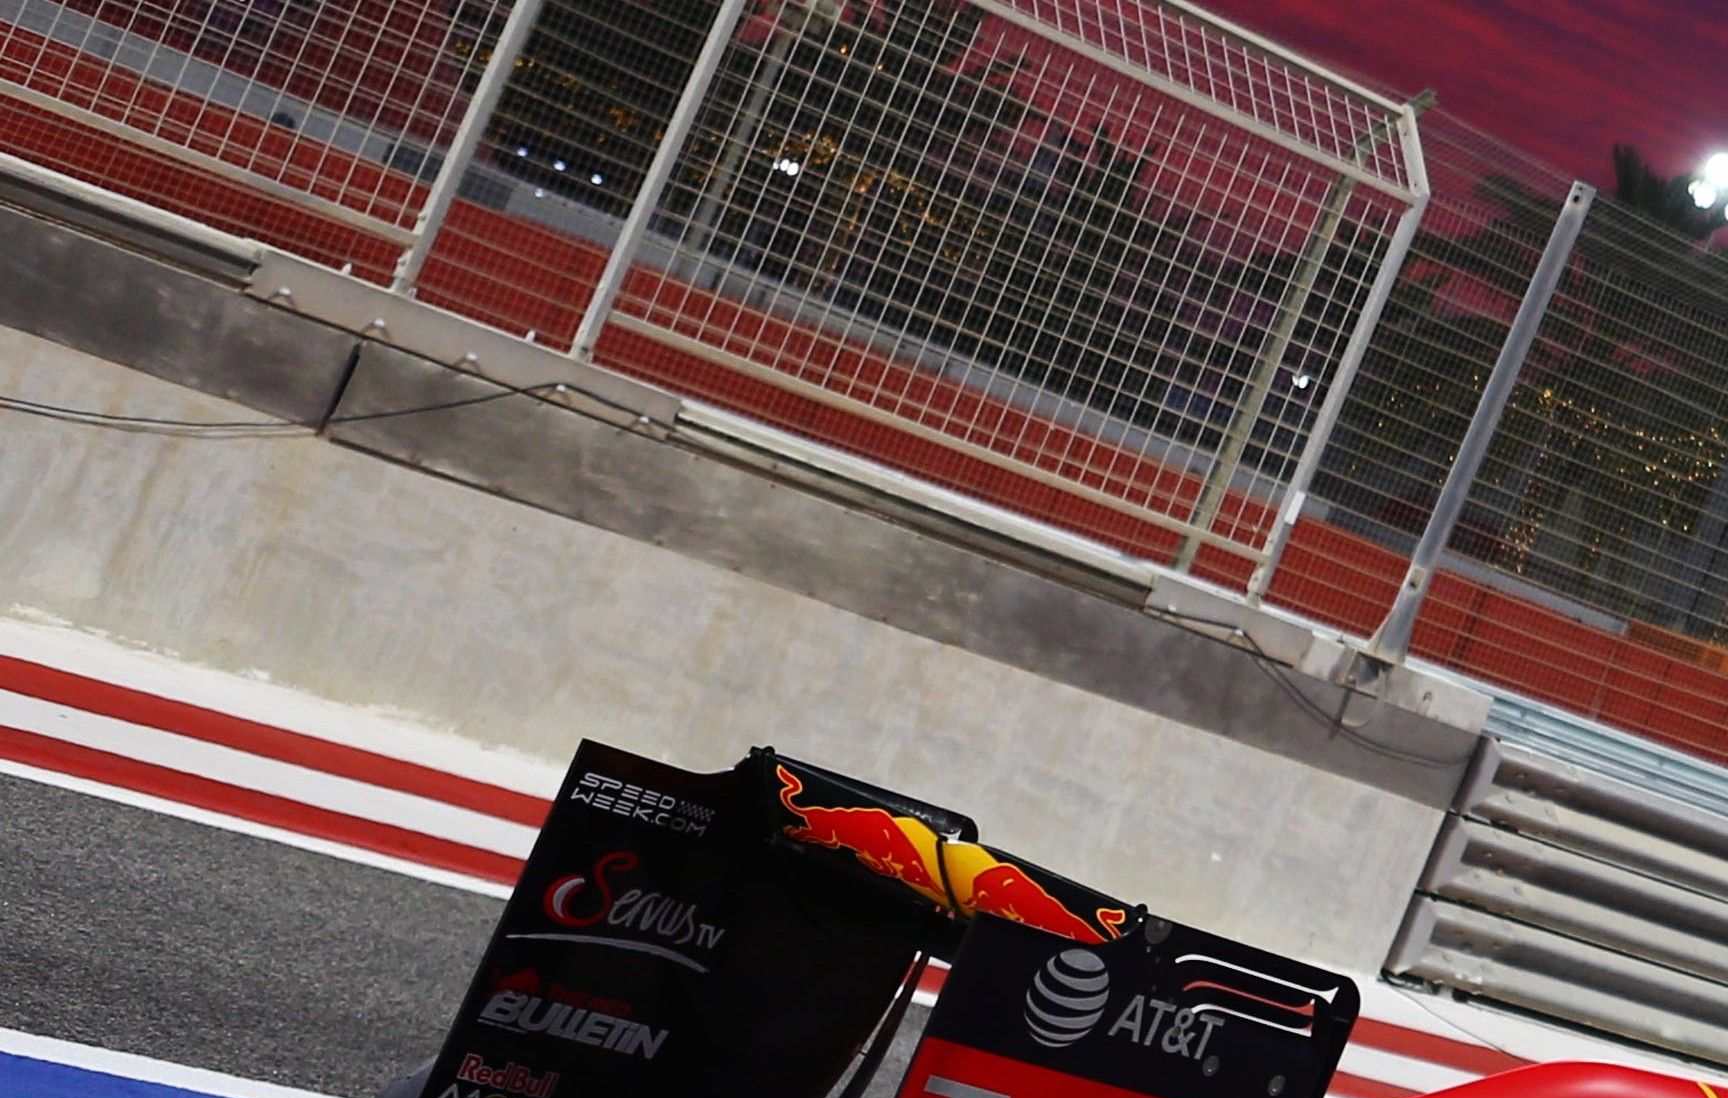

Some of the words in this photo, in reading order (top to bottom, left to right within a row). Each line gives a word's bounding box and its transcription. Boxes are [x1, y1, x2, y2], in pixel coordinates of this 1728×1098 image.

[570, 788, 708, 837] WEEK.COM
[579, 772, 676, 811] SPEED
[1108, 994, 1225, 1061] AT&T
